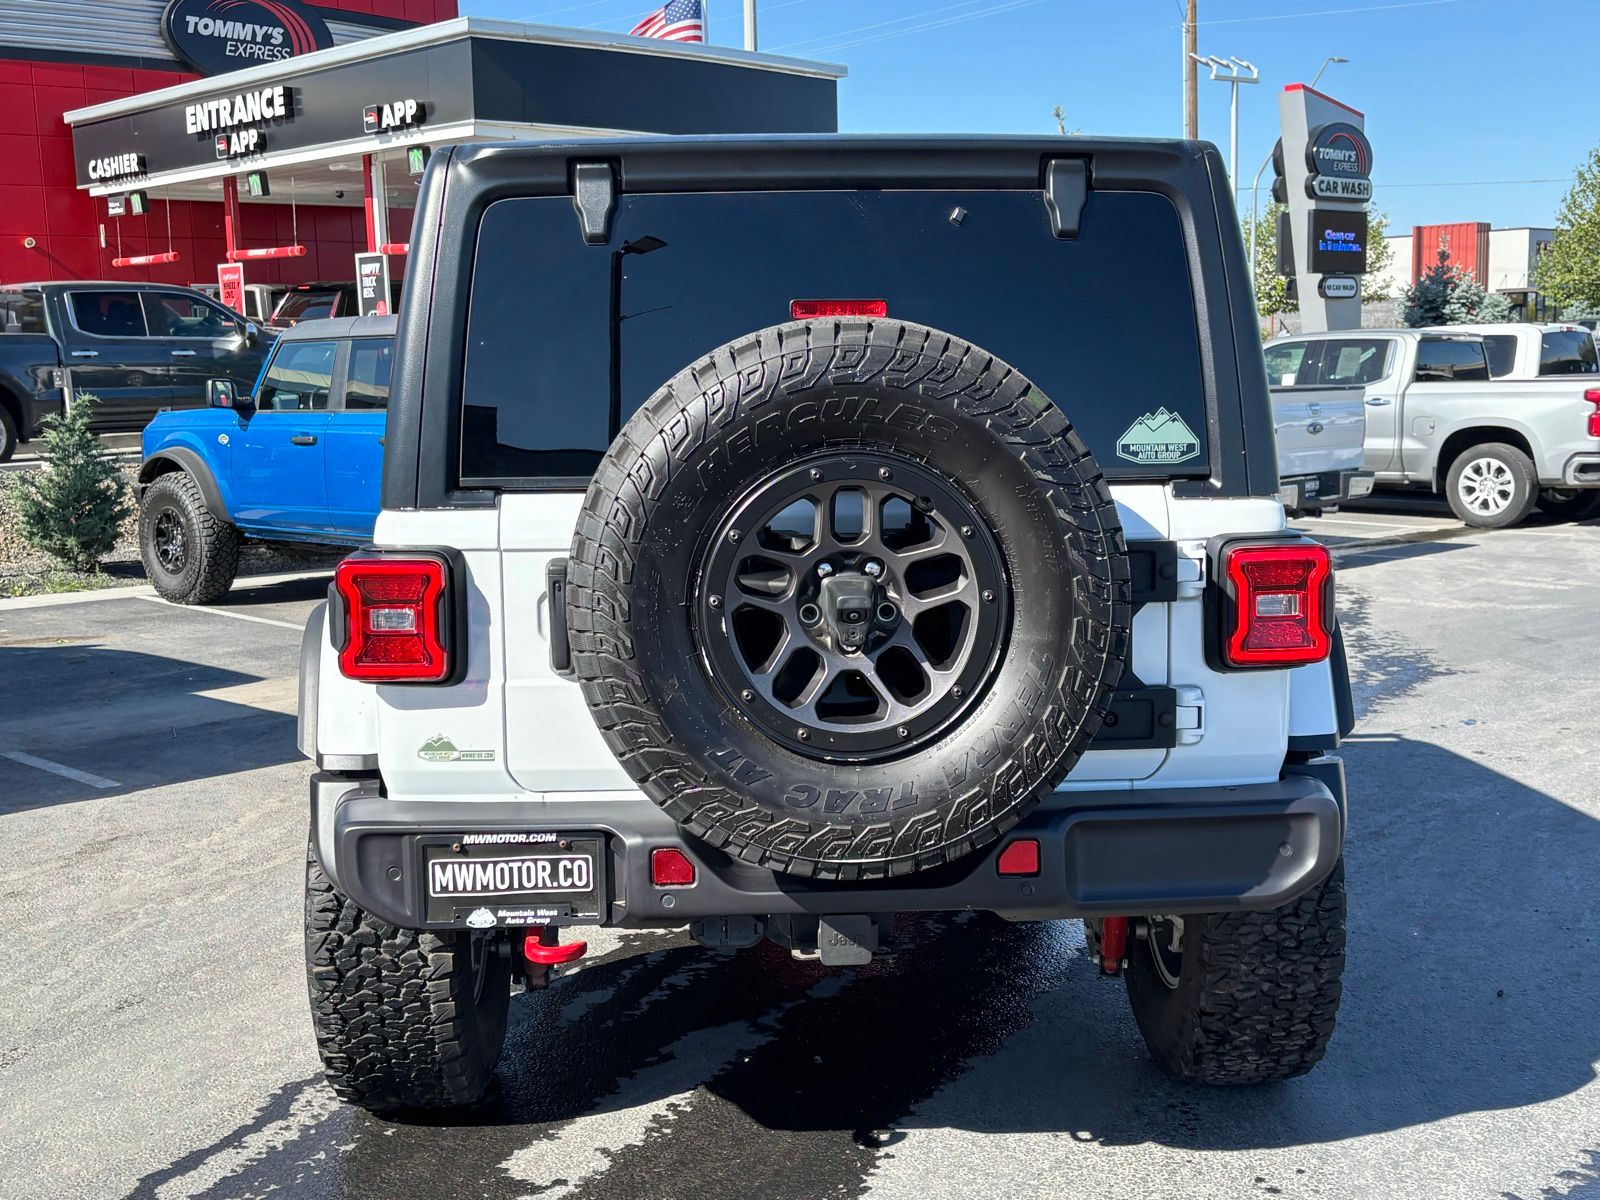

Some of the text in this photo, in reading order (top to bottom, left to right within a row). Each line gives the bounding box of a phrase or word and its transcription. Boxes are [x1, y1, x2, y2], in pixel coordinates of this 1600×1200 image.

[185, 15, 285, 45] TOMMY'S
[225, 41, 290, 61] EXPRESS
[185, 85, 286, 135] ENTRANCE
[382, 98, 417, 129] APP
[230, 129, 258, 155] APP
[88, 152, 139, 180] CASHIER
[1319, 147, 1357, 162] TOMMY'S
[1333, 161, 1358, 172] EXPRESS
[1318, 180, 1369, 196] CAR WASH
[697, 396, 959, 491] HERCULES
[1129, 443, 1188, 452] MOUNTAIN WEST
[1137, 451, 1181, 460] AUTO GROUP
[704, 748, 773, 786] AT
[784, 780, 919, 814] TRAC
[462, 832, 557, 845] MWMOTOR.COM
[434, 859, 588, 892] MWMOTOR.CO
[497, 908, 558, 917] Mountain West
[505, 917, 525, 925] Auto
[526, 916, 551, 926] Group
